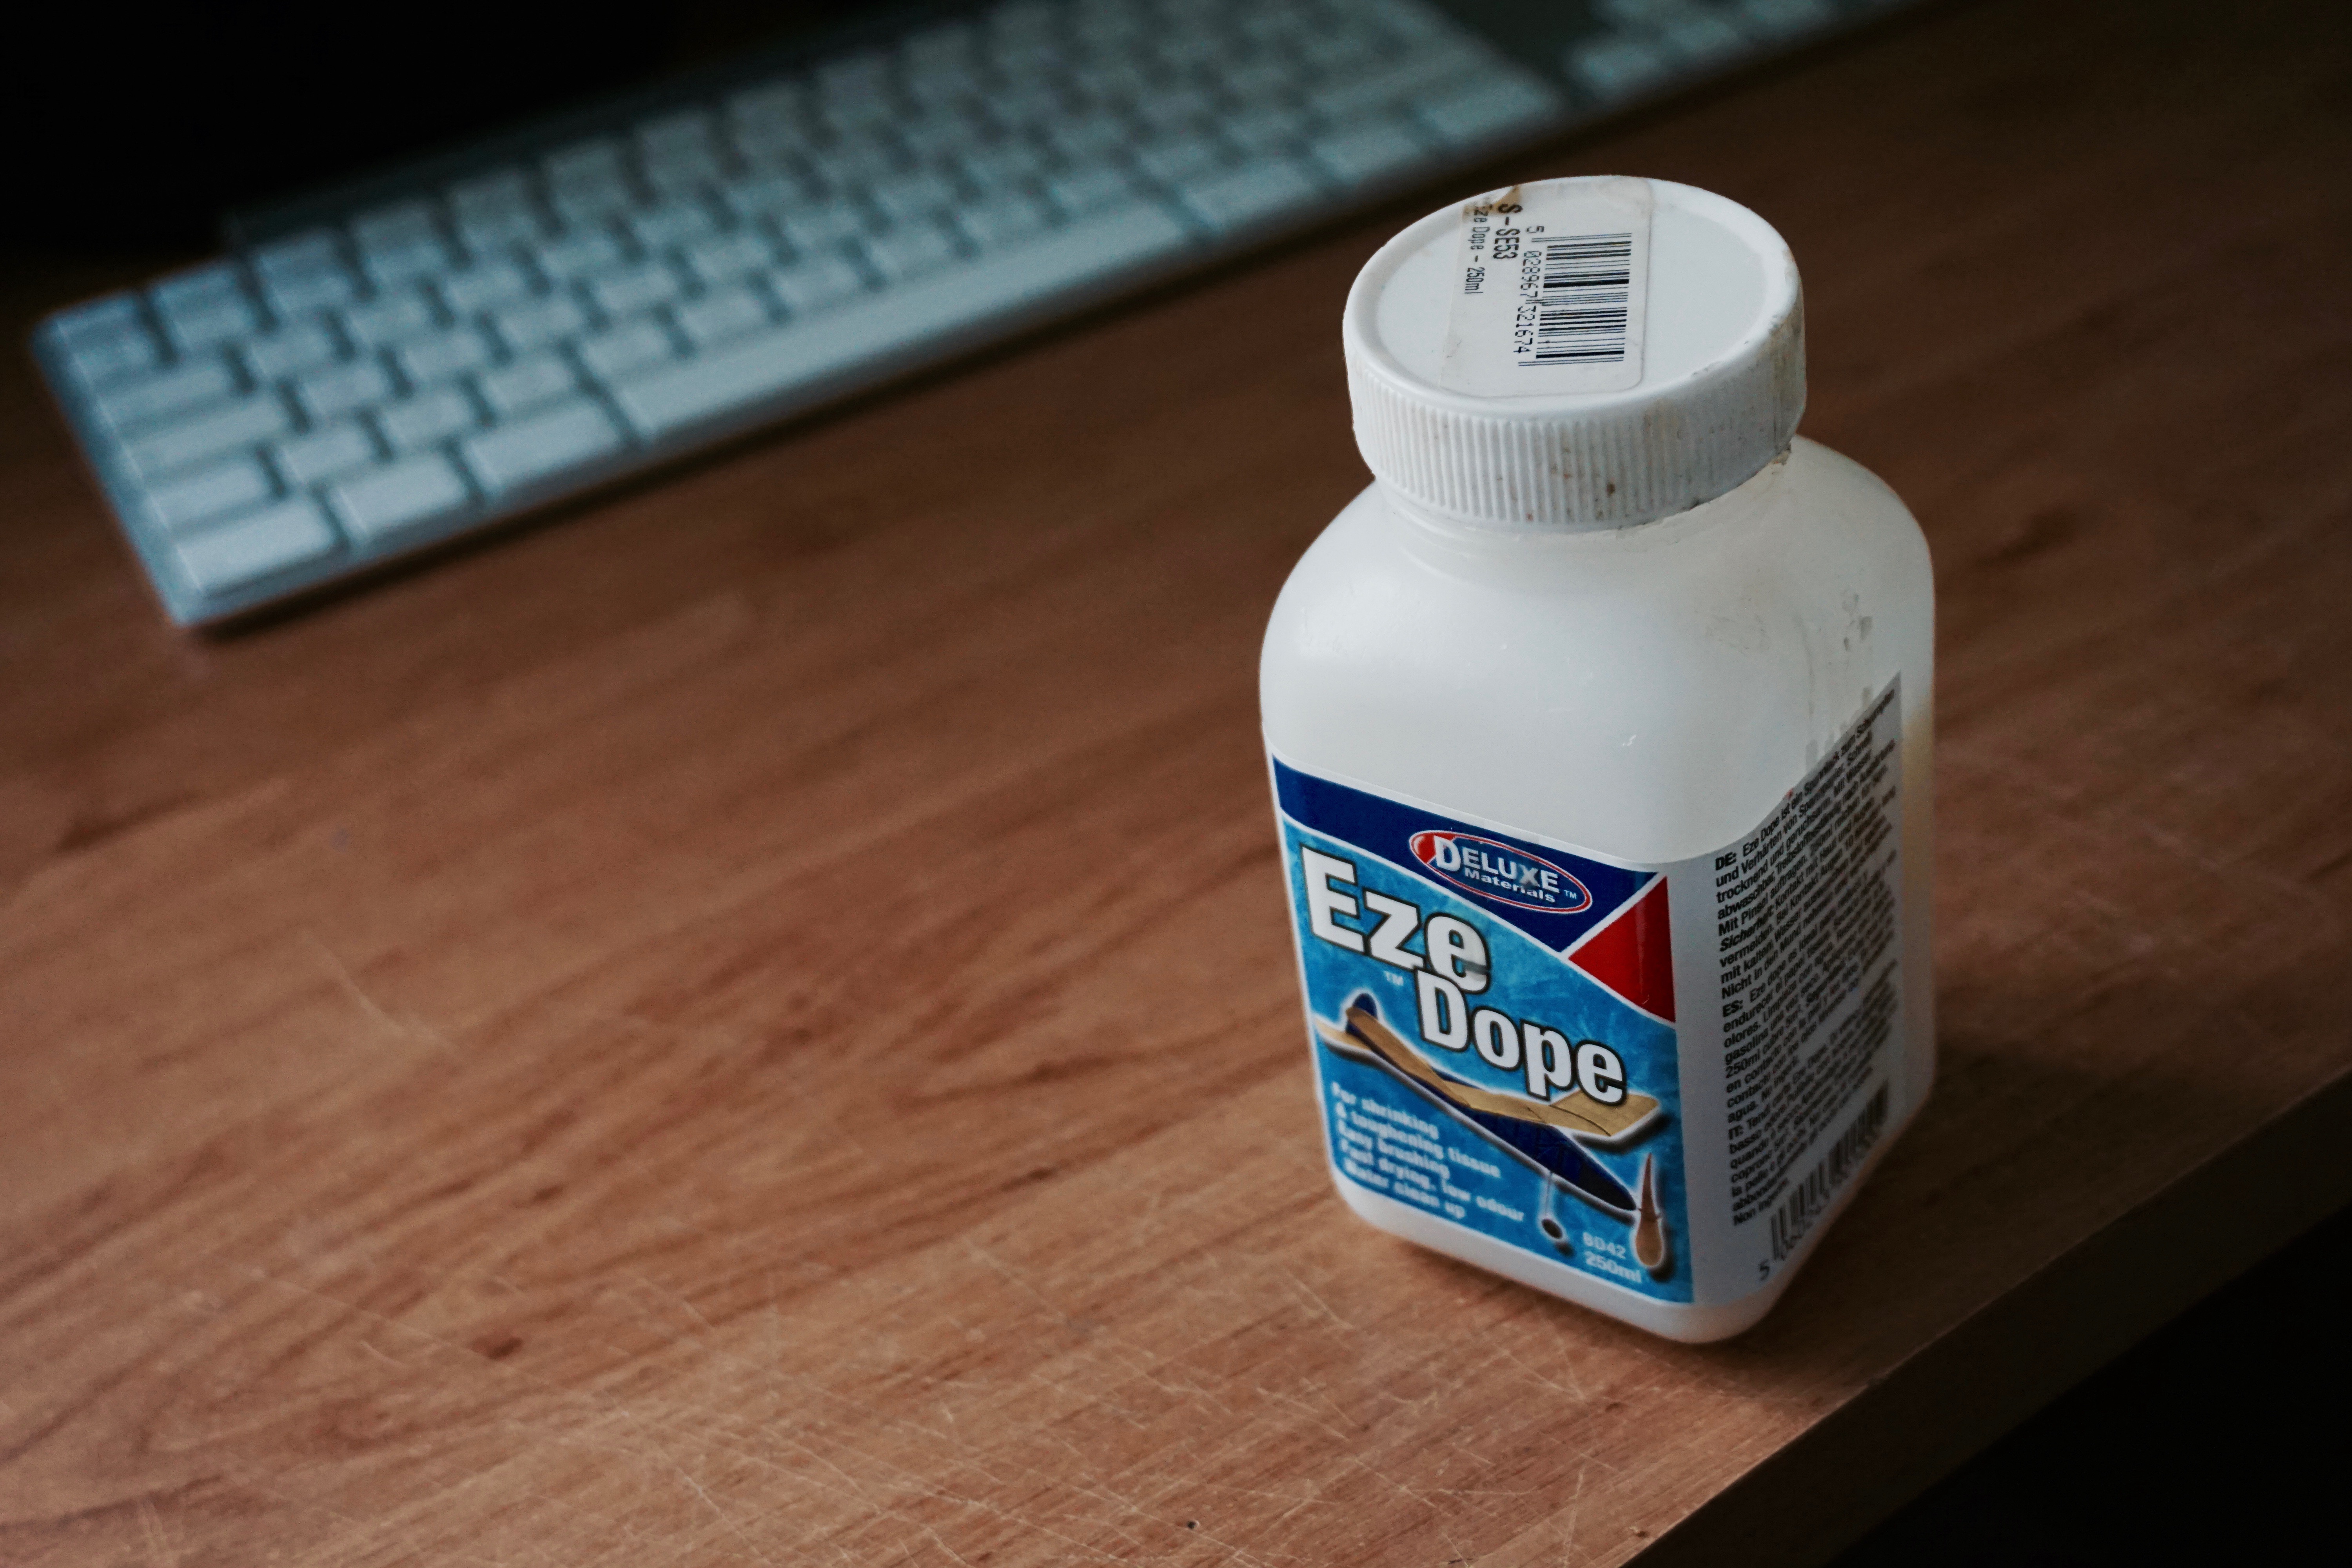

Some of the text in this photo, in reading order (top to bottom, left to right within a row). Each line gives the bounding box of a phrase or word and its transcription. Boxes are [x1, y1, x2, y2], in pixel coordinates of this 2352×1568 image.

[1474, 202, 1489, 223] ze
[1468, 227, 1490, 250] Dope
[1464, 267, 1485, 294] 250ml
[1520, 250, 1542, 298] 028967
[1514, 306, 1536, 354] 321674
[1715, 852, 1736, 870] DE:
[1742, 838, 1759, 857] Eze
[1760, 816, 1779, 842] Dope
[1716, 866, 1739, 887] und
[1783, 814, 1797, 833] von
[1435, 836, 1560, 894] DELUXE
[1717, 860, 1768, 903] trocknend
[1770, 842, 1784, 866] und
[1463, 867, 1555, 904] Materials
[1775, 872, 1804, 909] Kontakt
[1299, 844, 1490, 995] Eze
[1718, 917, 1738, 936] Mit
[1741, 893, 1768, 924] Pinsel
[1720, 965, 1740, 984] mit
[1722, 974, 1751, 999] Nicht
[1754, 967, 1762, 980] in
[1764, 949, 1778, 970] den
[1780, 922, 1801, 953] Mund
[1722, 1000, 1743, 1017] ES:
[1749, 982, 1766, 1002] Eze
[1723, 990, 1773, 1032] endurecer
[1414, 966, 1628, 1104] Dope
[1724, 1022, 1760, 1047] olores.
[1725, 1028, 1768, 1065] gasolina
[1726, 1049, 1760, 1078] 250ml
[1726, 1079, 1741, 1093] en
[1448, 1147, 1501, 1178] tissue
[1584, 1252, 1642, 1283] 250ml
